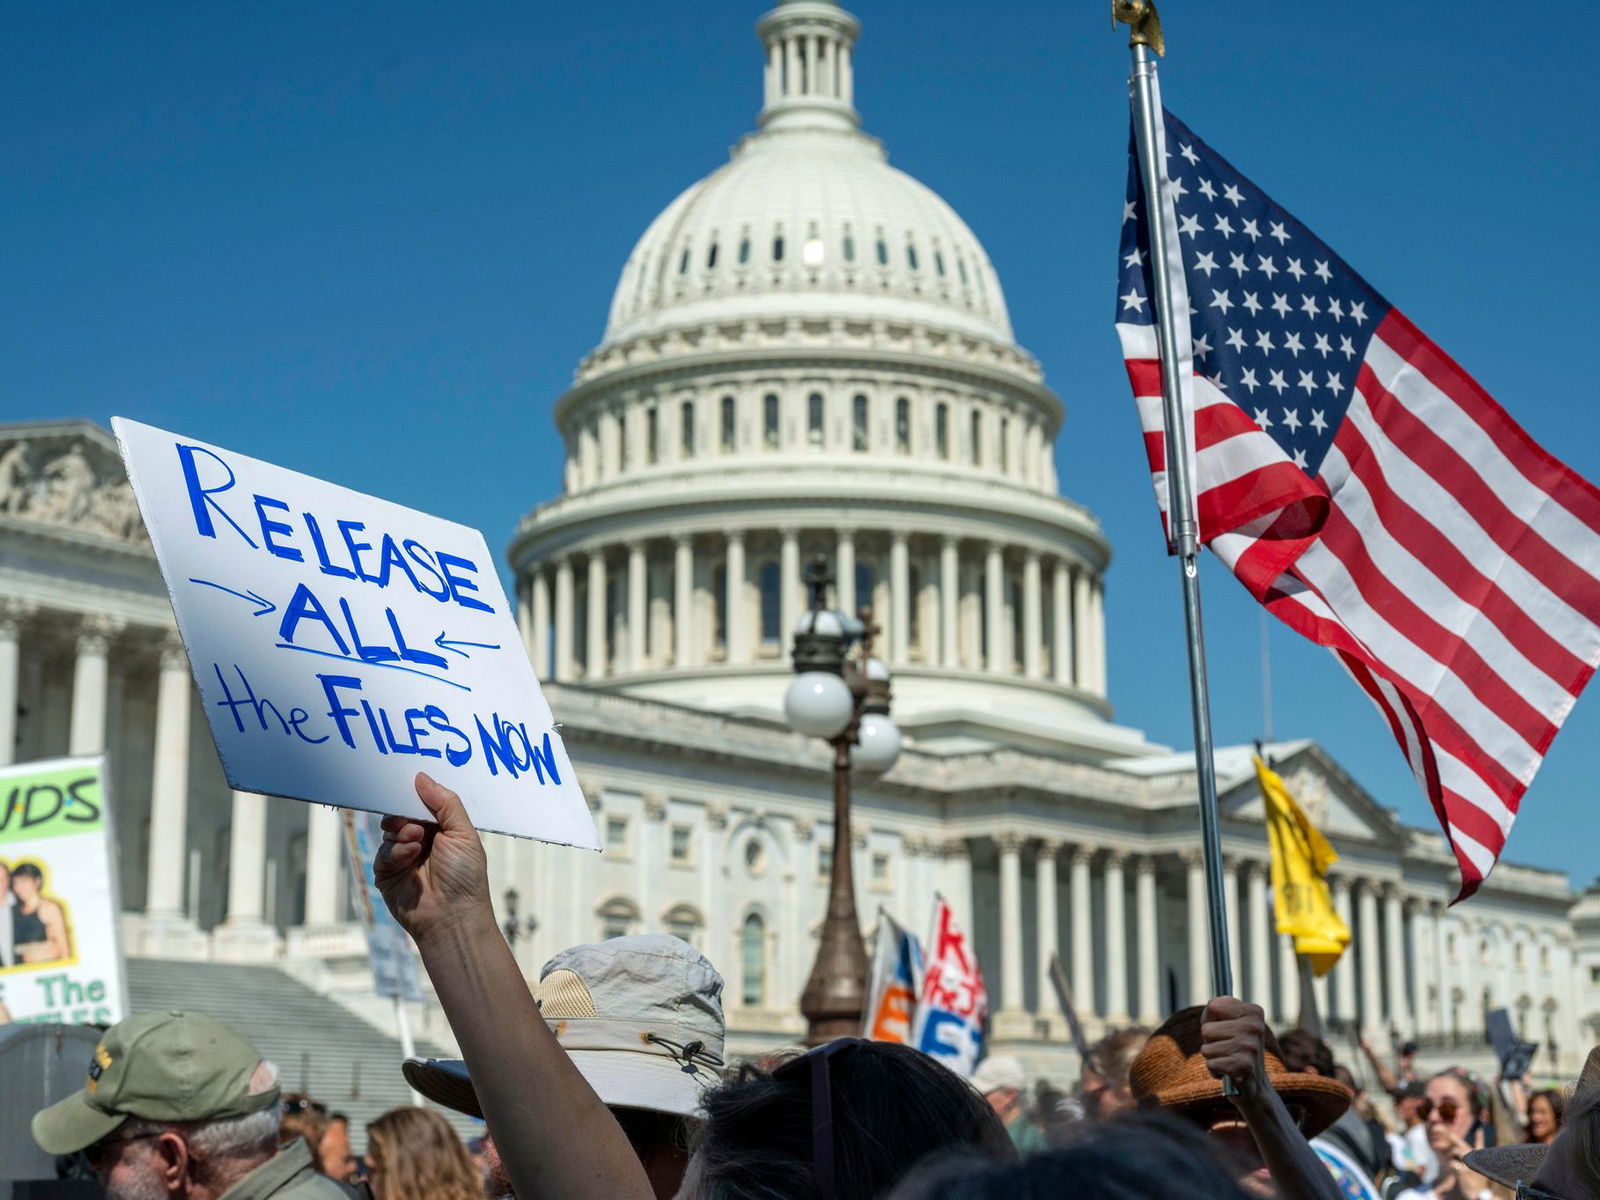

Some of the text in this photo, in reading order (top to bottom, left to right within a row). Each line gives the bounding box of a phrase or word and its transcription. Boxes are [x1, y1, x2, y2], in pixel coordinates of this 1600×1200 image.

[175, 443, 495, 613] RELEASE
[279, 583, 449, 670] ALL
[214, 663, 562, 786] the FILES NOW
[35, 973, 106, 1007] The
